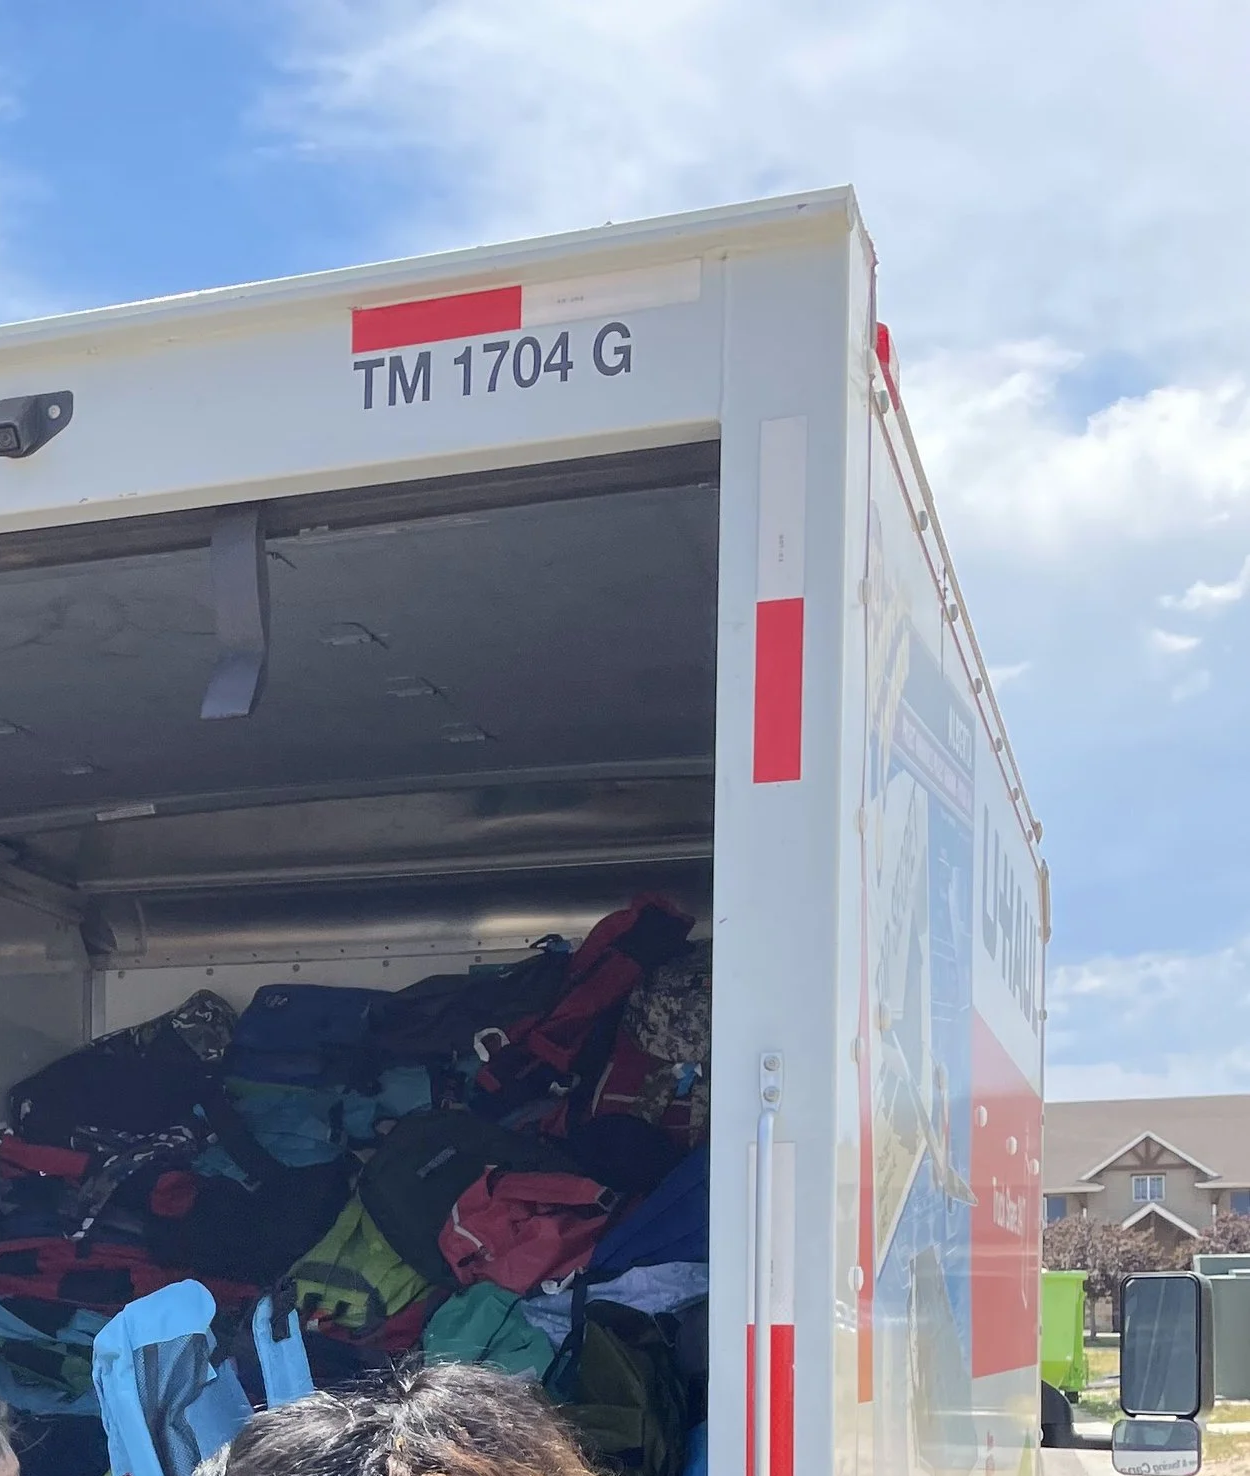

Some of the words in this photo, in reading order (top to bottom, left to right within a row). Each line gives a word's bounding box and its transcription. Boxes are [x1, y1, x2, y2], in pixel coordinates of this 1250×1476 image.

[353, 351, 431, 410] TM
[453, 331, 573, 396] 1704
[593, 321, 631, 377] G
